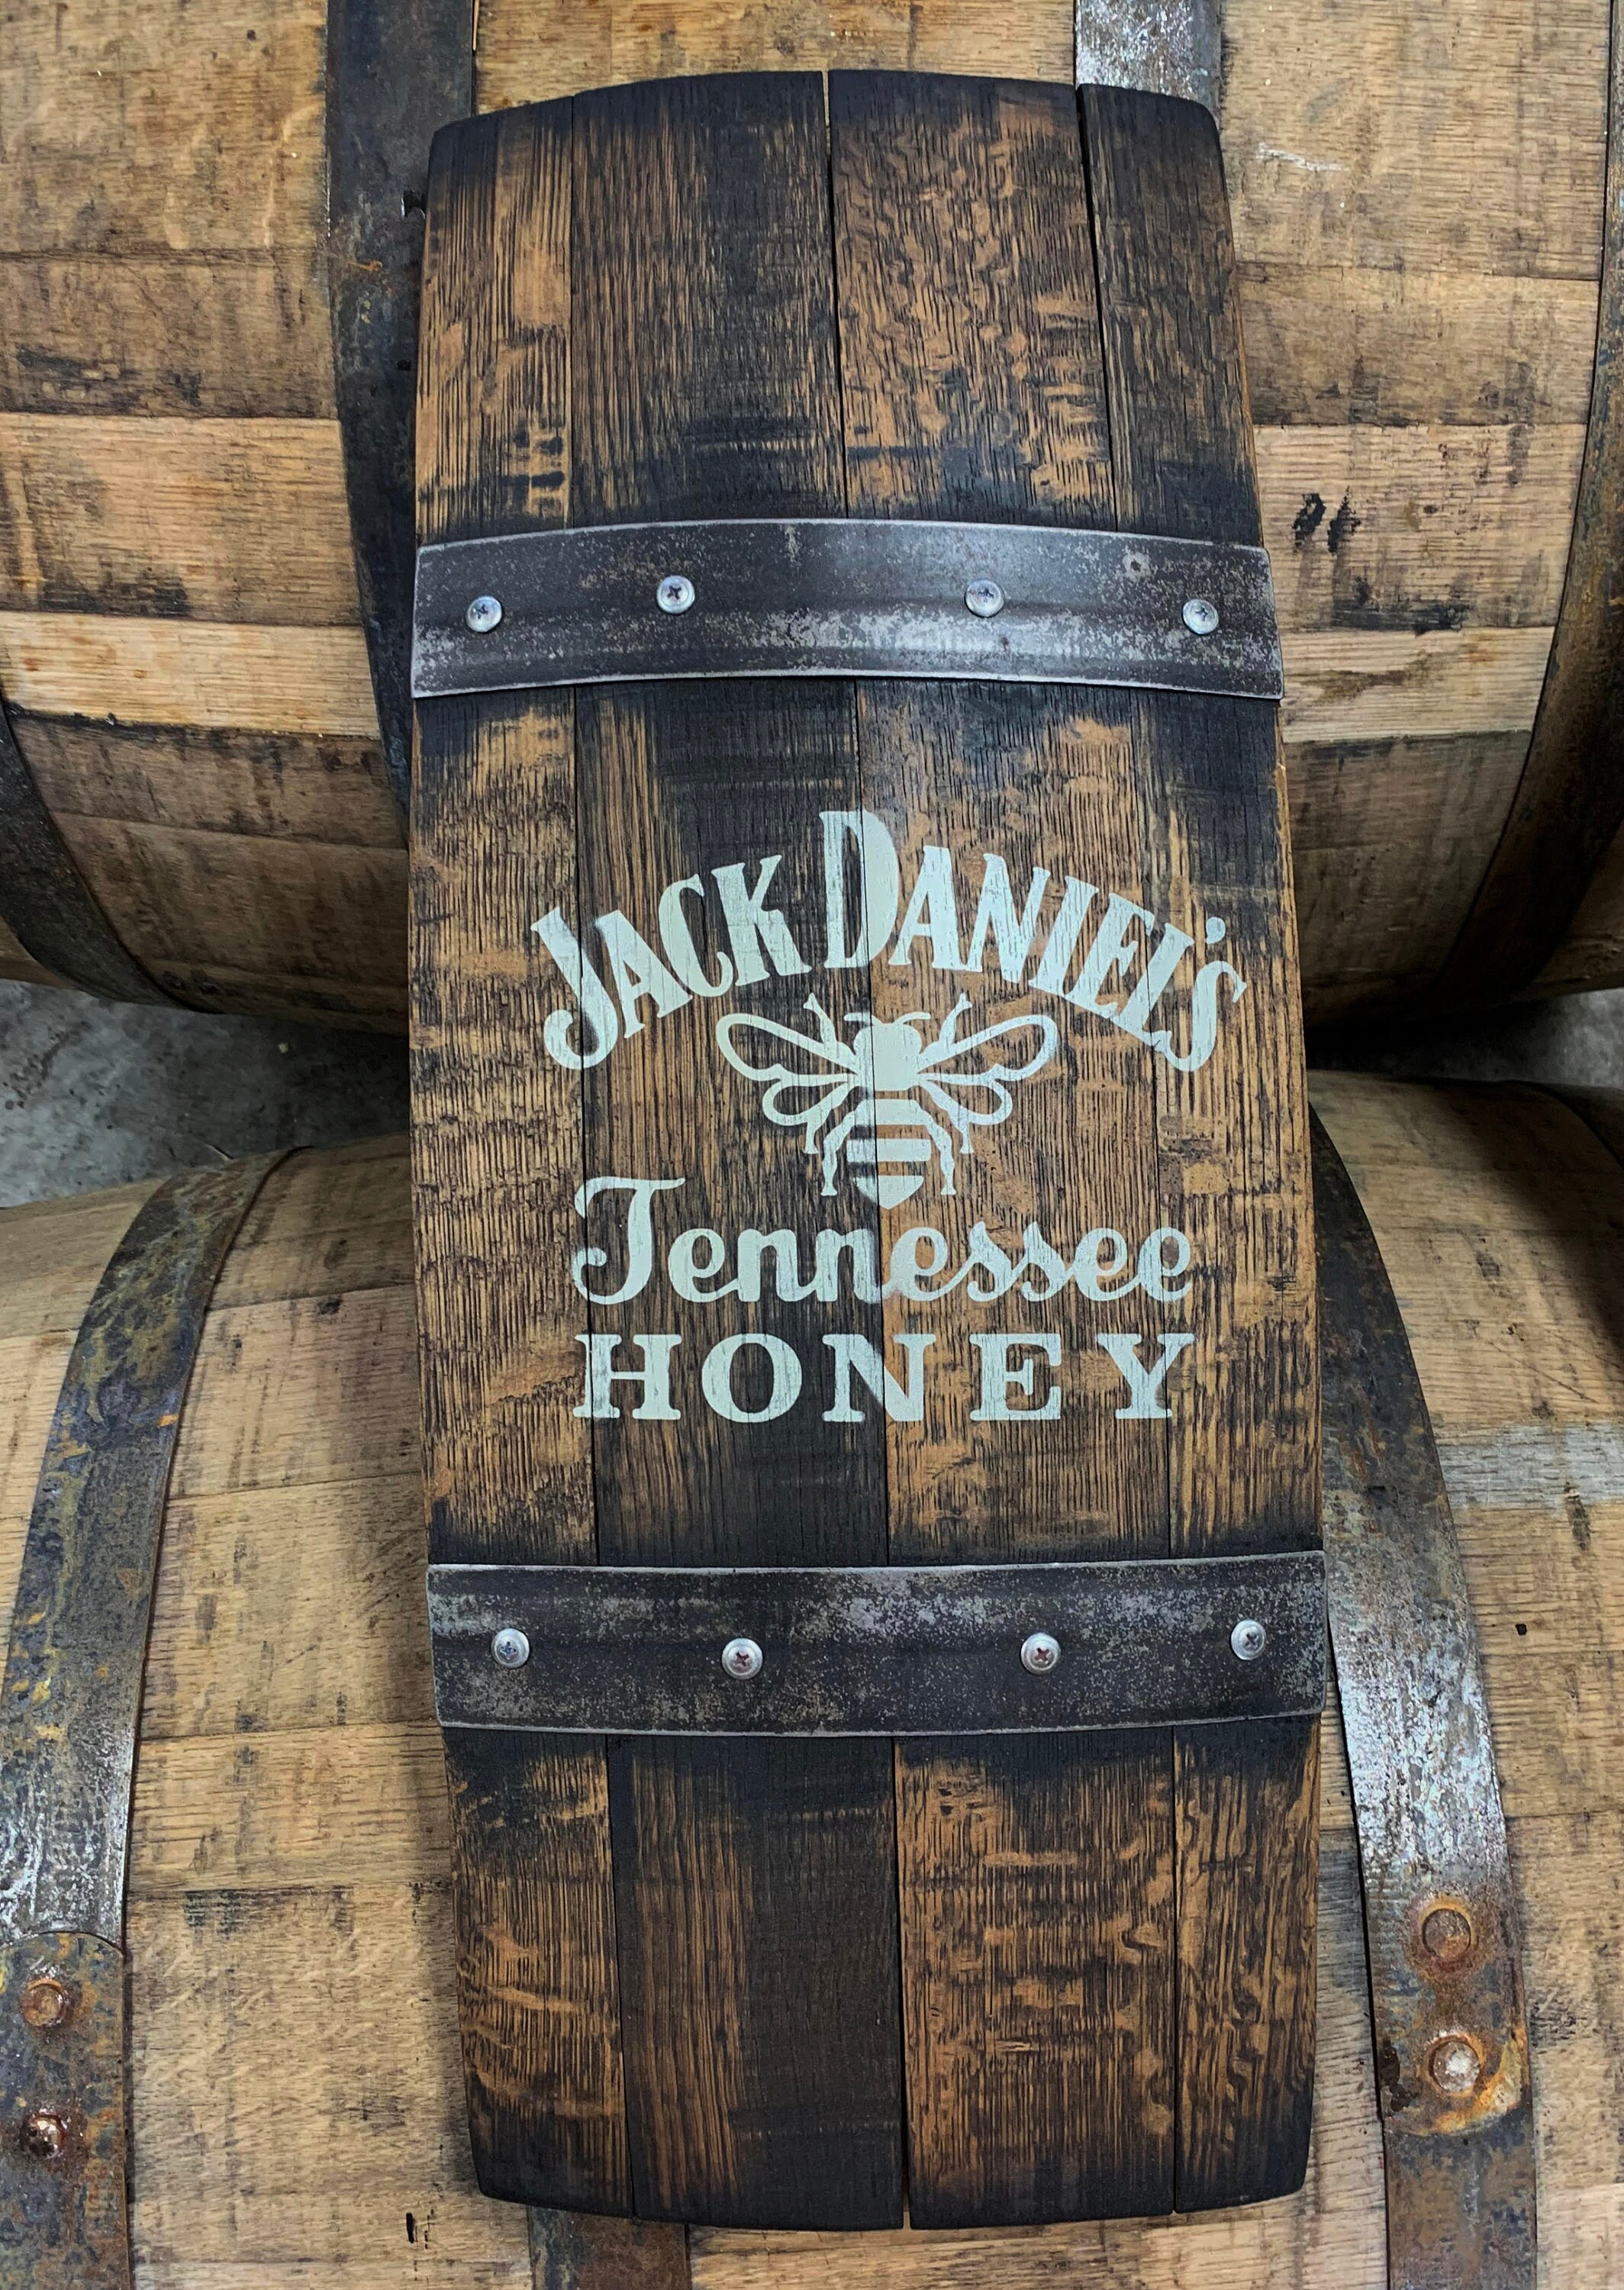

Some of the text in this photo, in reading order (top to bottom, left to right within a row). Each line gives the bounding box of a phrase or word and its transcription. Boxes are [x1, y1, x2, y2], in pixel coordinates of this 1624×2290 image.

[529, 809, 1247, 1072] JACK DANIEL'S
[571, 1176, 1192, 1305] Tennessee
[572, 1331, 1196, 1423] HONEY
